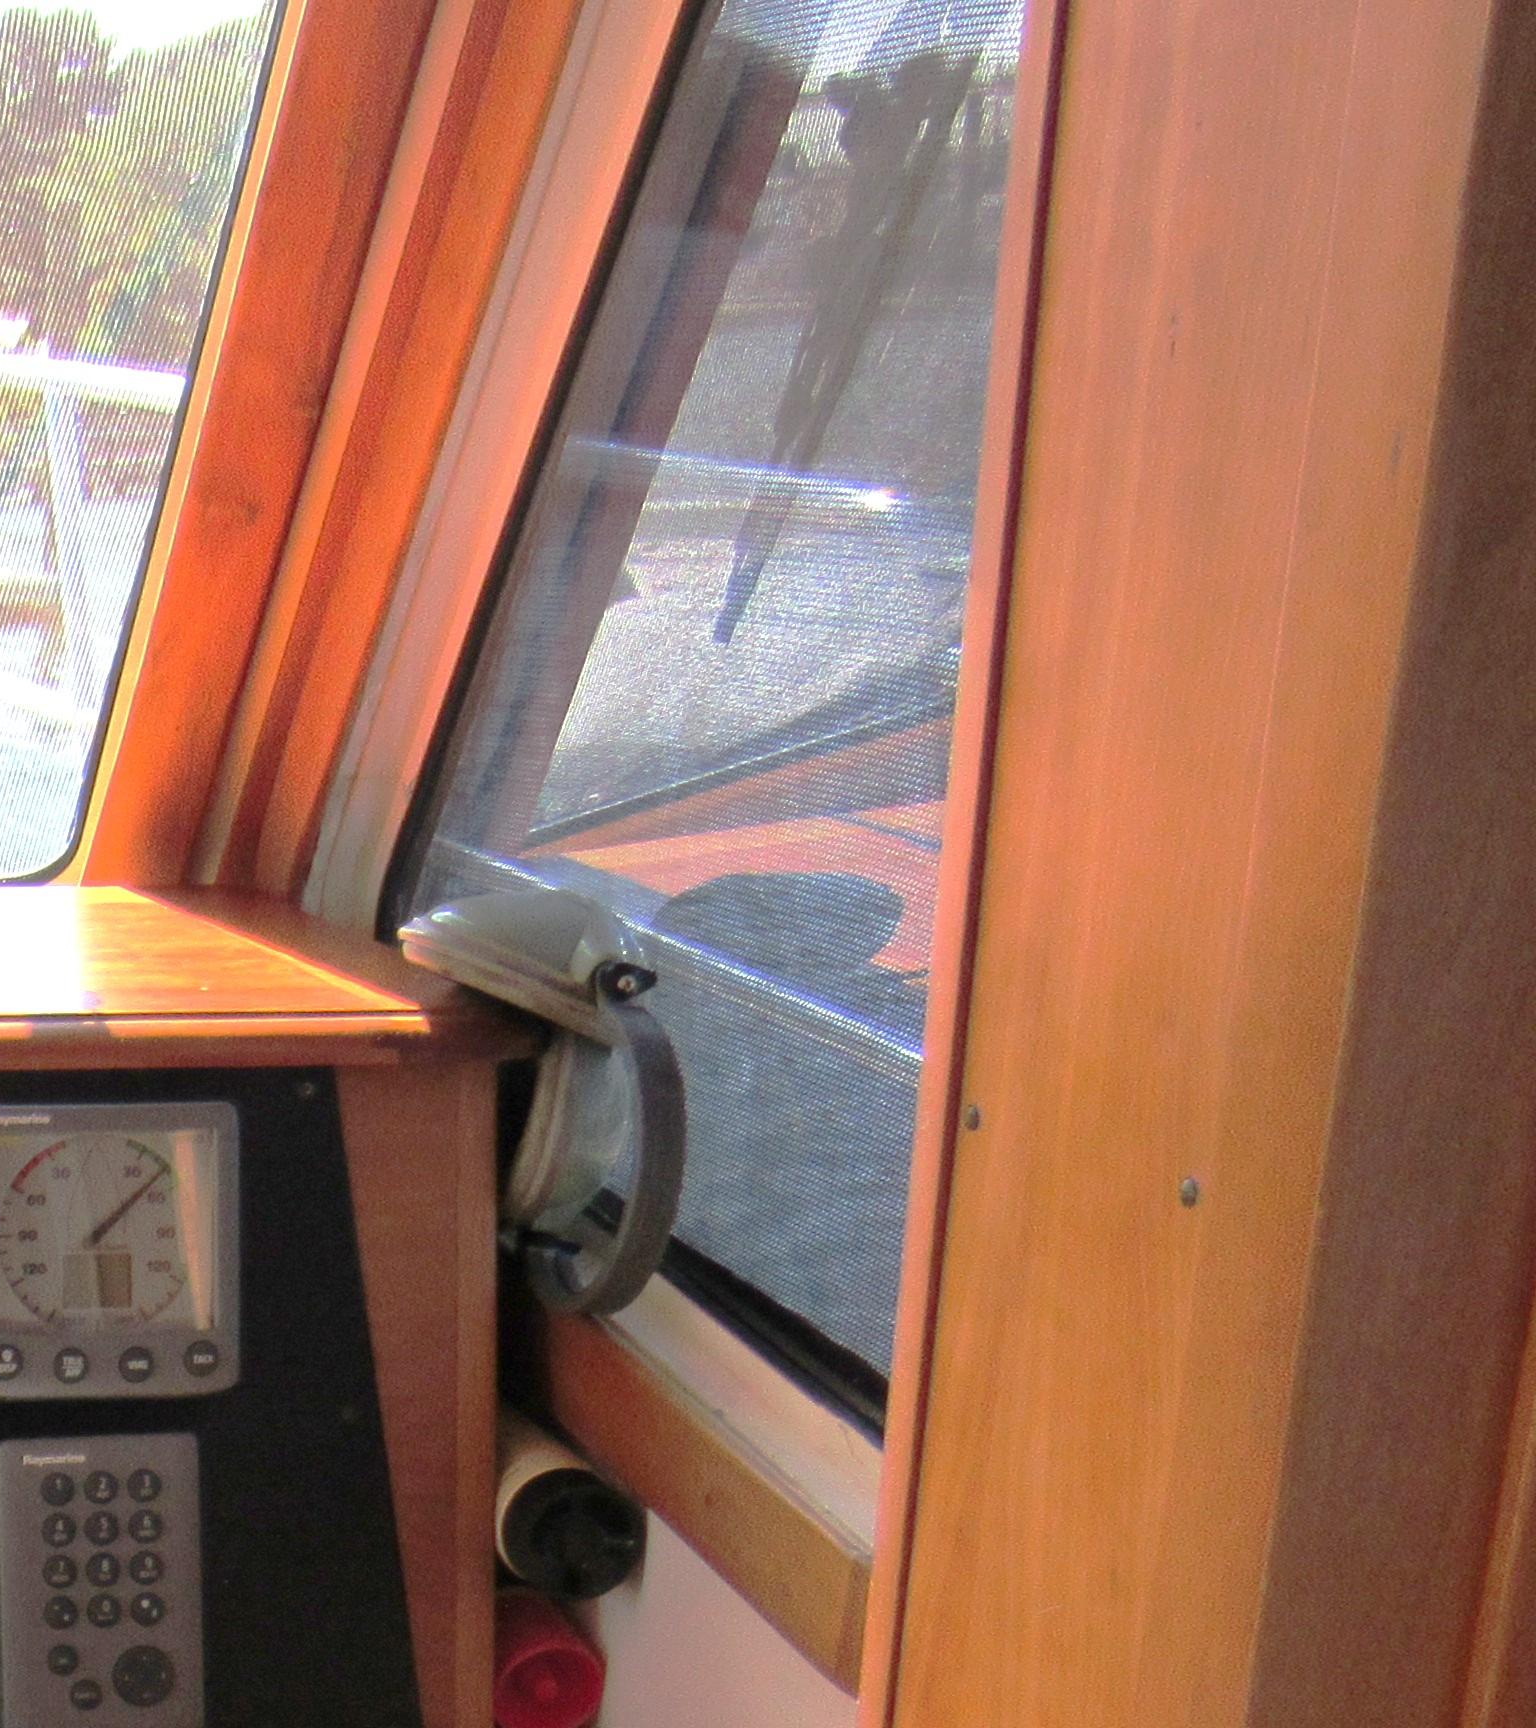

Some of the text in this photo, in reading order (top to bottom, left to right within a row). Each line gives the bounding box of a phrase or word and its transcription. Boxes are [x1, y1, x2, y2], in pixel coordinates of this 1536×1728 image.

[51, 1166, 71, 1180] 30
[26, 1193, 47, 1207] 60
[17, 1229, 39, 1243] 90
[155, 1226, 176, 1240] 90
